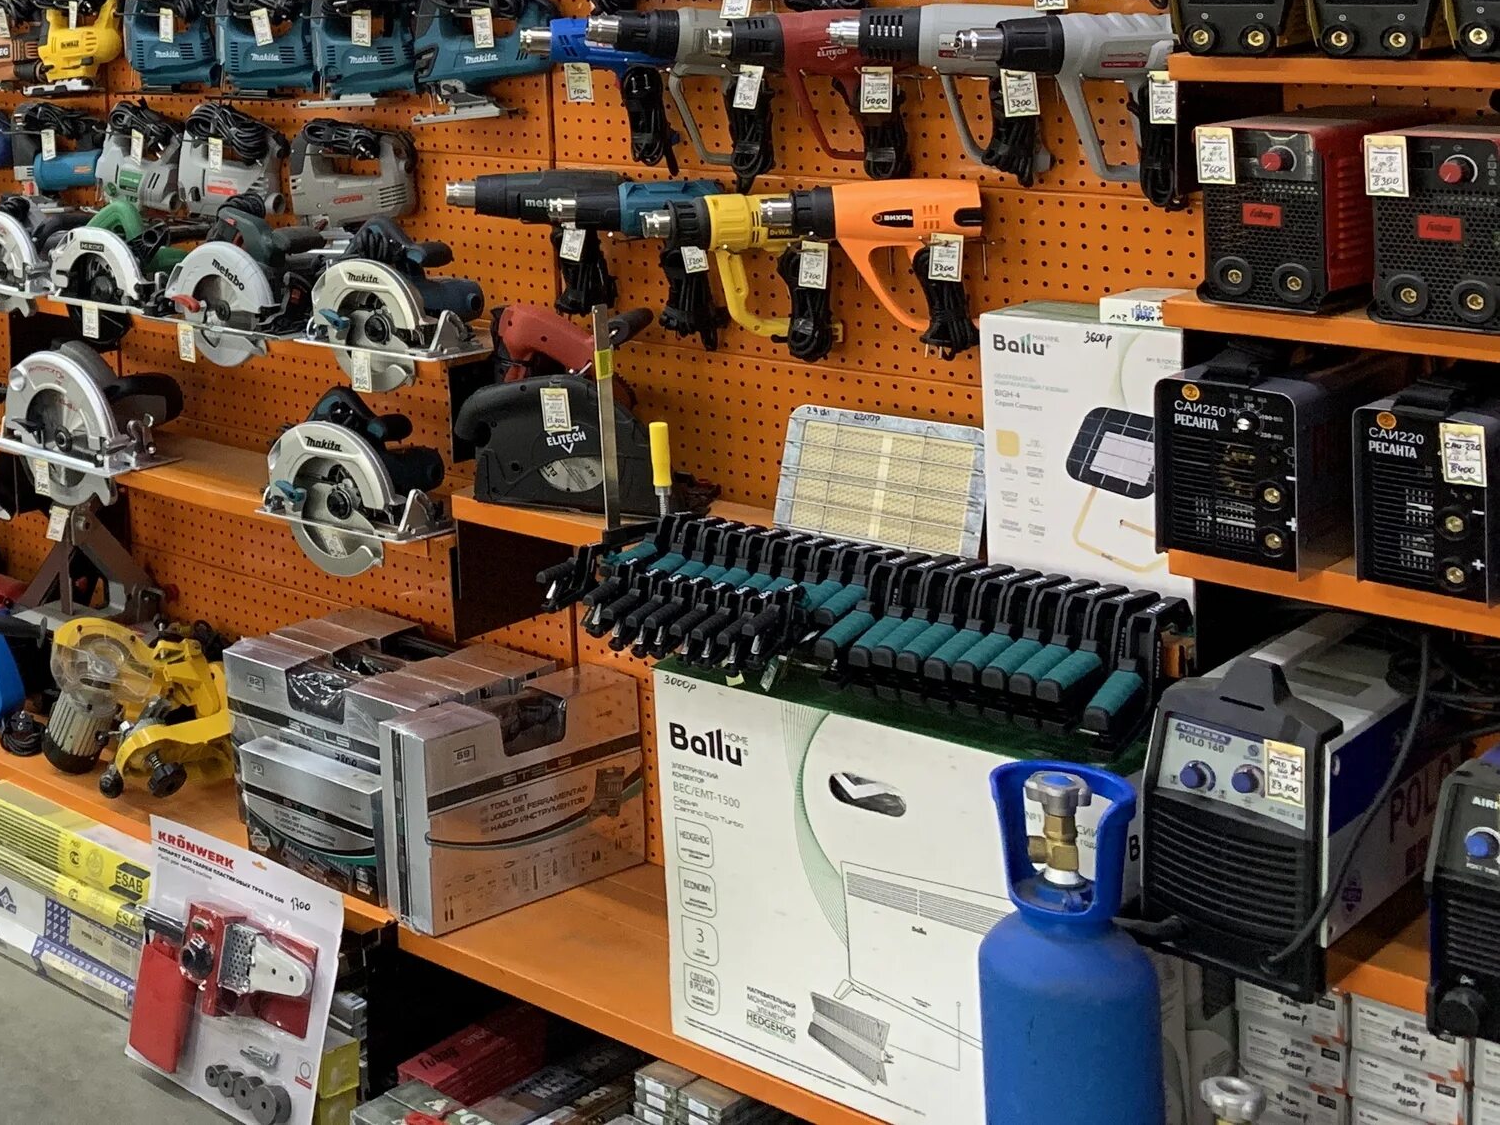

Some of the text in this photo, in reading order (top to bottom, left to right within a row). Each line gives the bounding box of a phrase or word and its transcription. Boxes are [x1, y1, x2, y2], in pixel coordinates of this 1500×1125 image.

[349, 55, 379, 65] Makita
[464, 52, 499, 65] Makita
[211, 258, 246, 292] metabo
[345, 271, 380, 285] Makita
[993, 333, 1045, 356] Ballu
[1174, 399, 1227, 418] САИ250
[1174, 413, 1220, 432] РЕСАНТА
[304, 435, 343, 454] Makita
[546, 431, 587, 447] ELITECH
[1368, 426, 1425, 445] САИ220
[1368, 439, 1418, 459] РЕСАНТА
[288, 719, 350, 749] STELS
[1178, 733, 1225, 754] POLO 160
[669, 722, 749, 767] Ballu HOME
[673, 781, 741, 809] BEC/EMT-1500
[679, 830, 711, 847] HEDGEHOG
[115, 871, 143, 894] ESAB
[683, 878, 712, 895] ECONOMY
[696, 927, 705, 944] 3
[746, 1011, 797, 1040] HEDGEHOG
